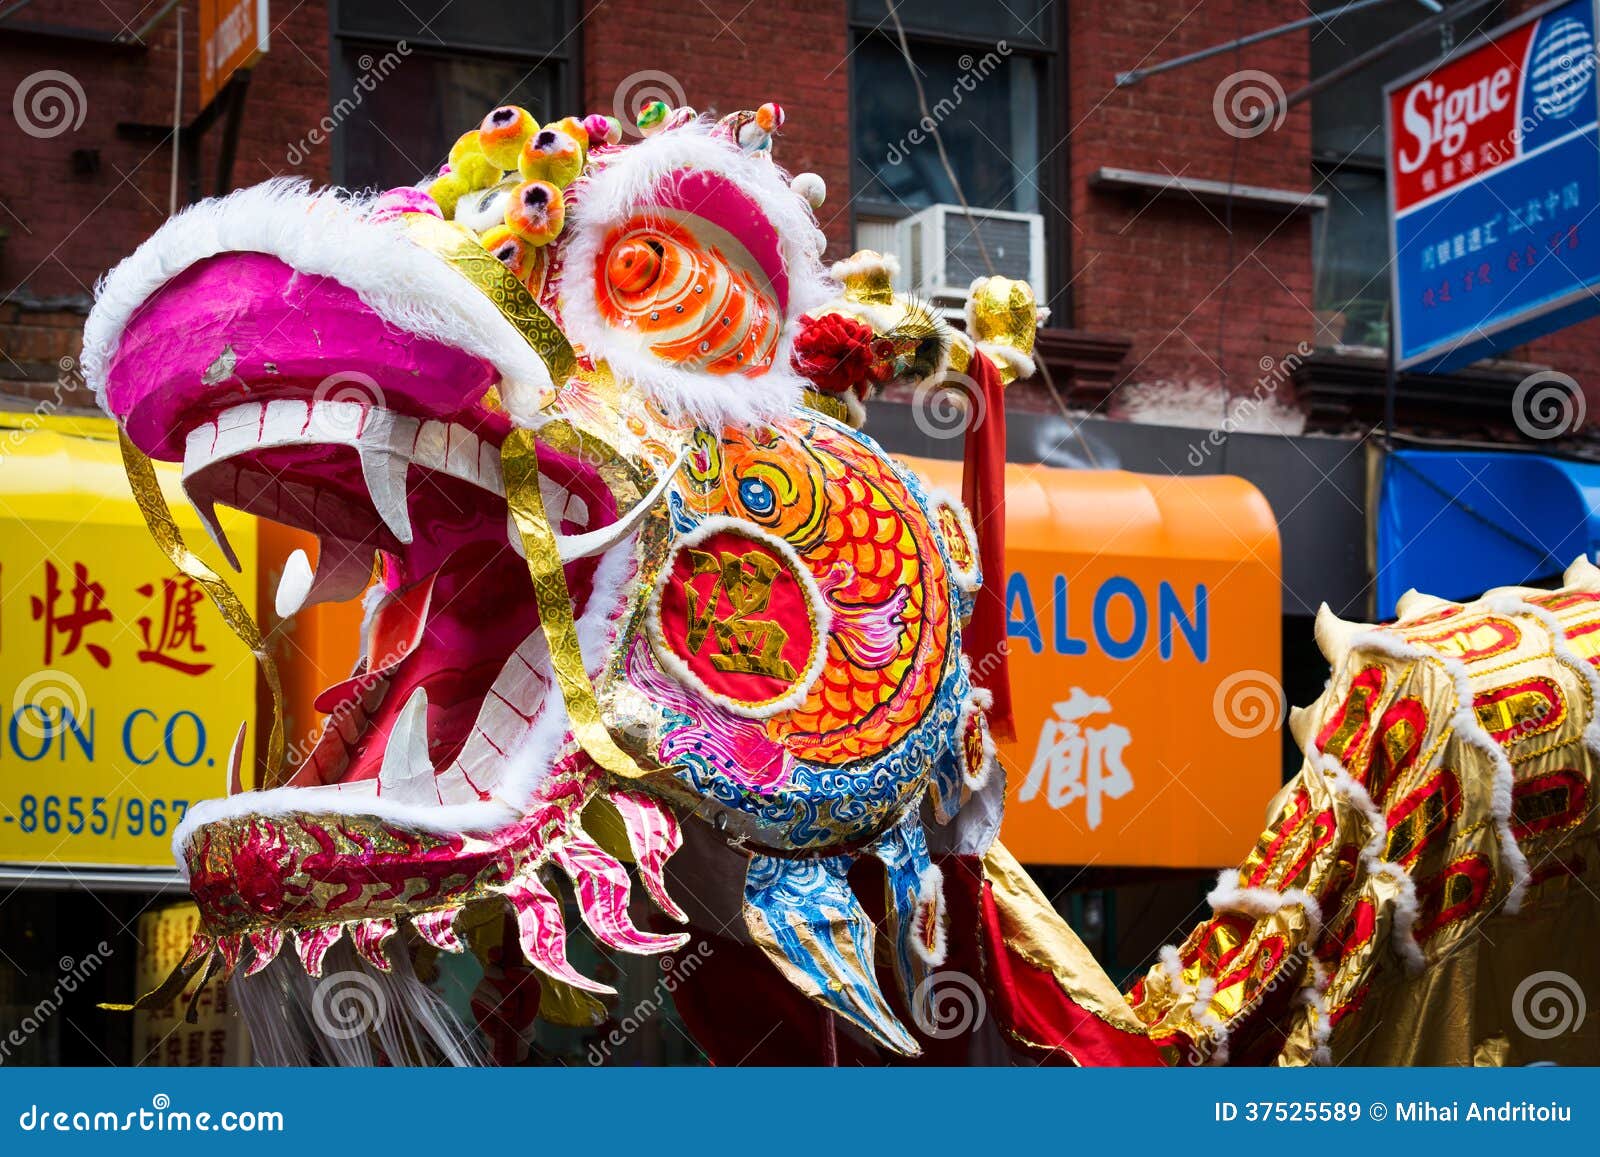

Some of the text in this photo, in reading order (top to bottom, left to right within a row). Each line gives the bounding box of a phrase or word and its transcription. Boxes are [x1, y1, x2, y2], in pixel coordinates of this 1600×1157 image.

[1399, 66, 1512, 174] Sigue
[0, 559, 215, 676] 快遞
[1006, 571, 1208, 663] ALON
[122, 708, 215, 767] CO.
[1018, 686, 1134, 830] 廊
